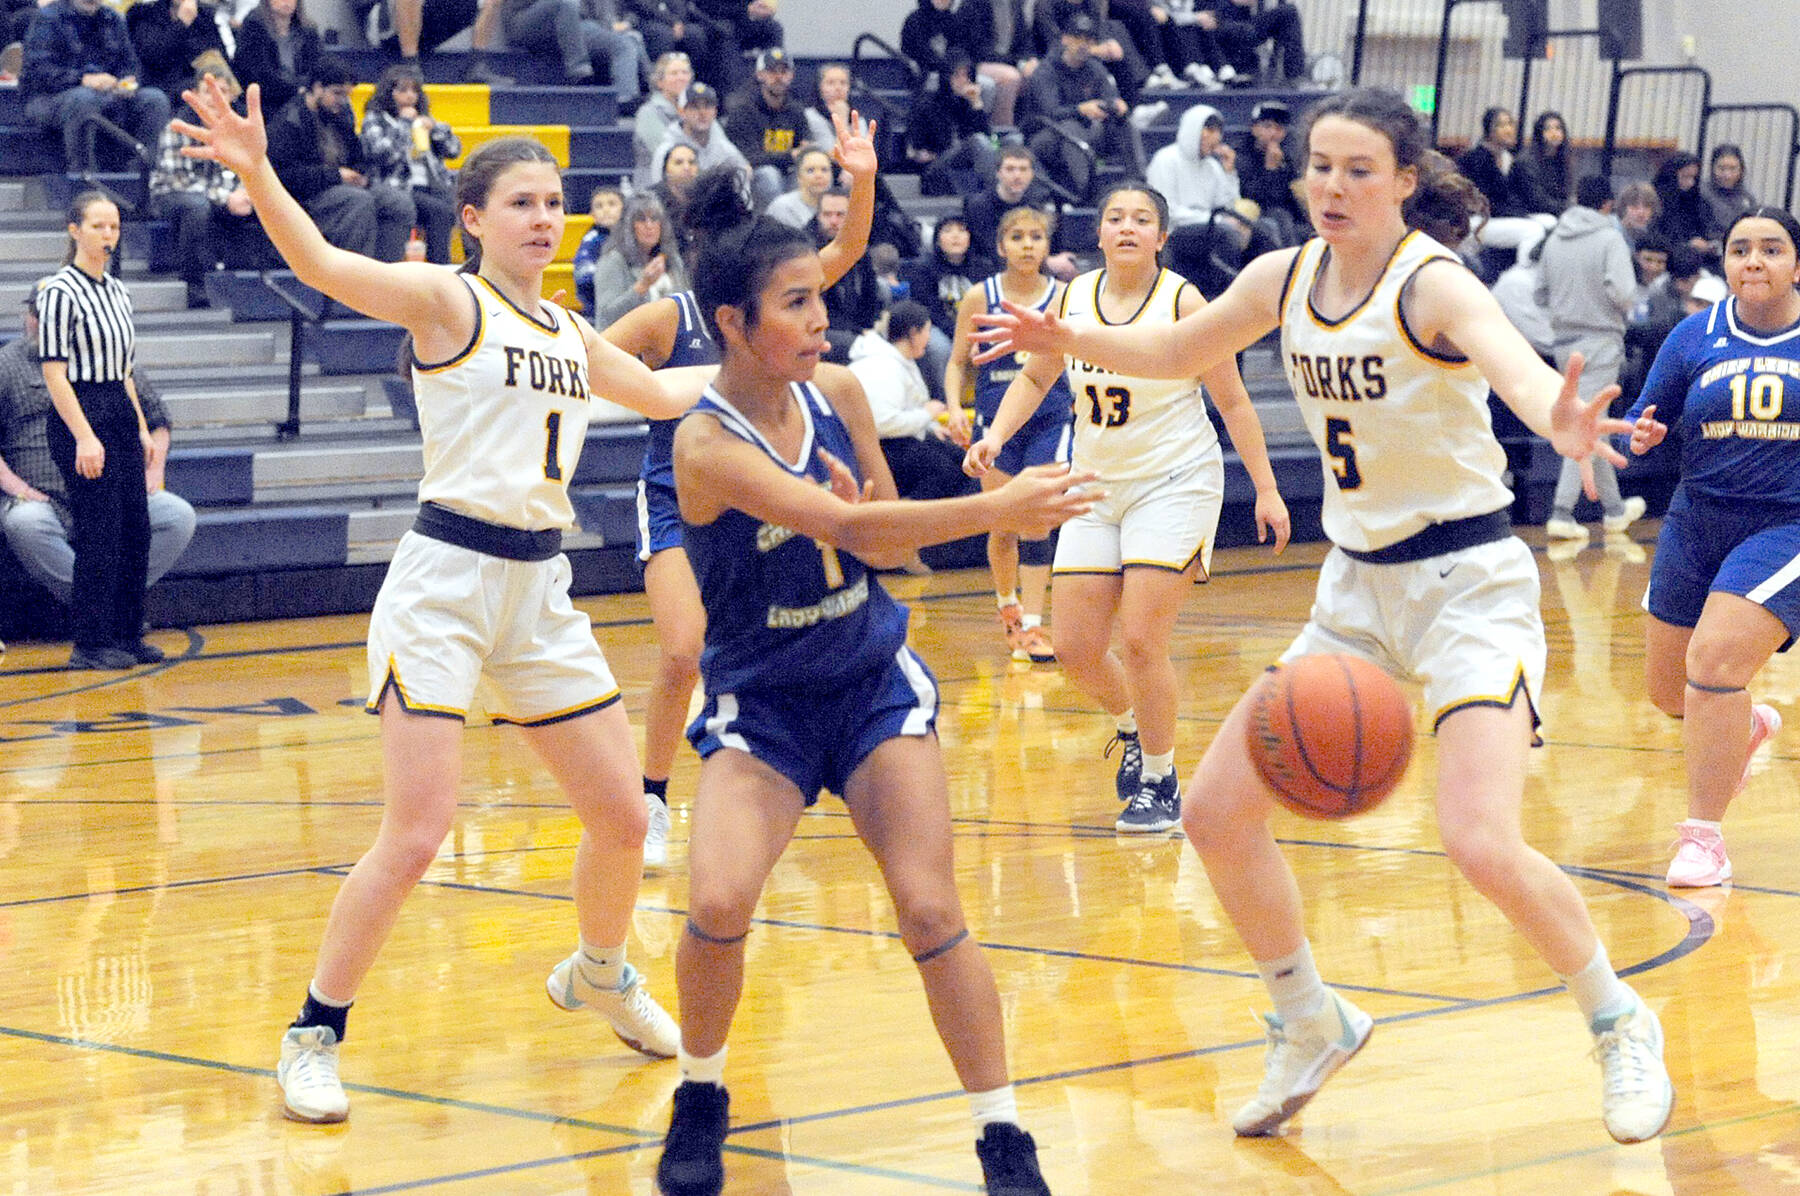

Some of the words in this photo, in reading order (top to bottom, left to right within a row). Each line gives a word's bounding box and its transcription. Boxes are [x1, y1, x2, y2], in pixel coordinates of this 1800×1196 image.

[504, 345, 590, 402] FORK
[1729, 374, 1784, 421] 10
[1085, 384, 1130, 428] 13
[543, 410, 564, 484] 1
[1325, 416, 1363, 492] 5
